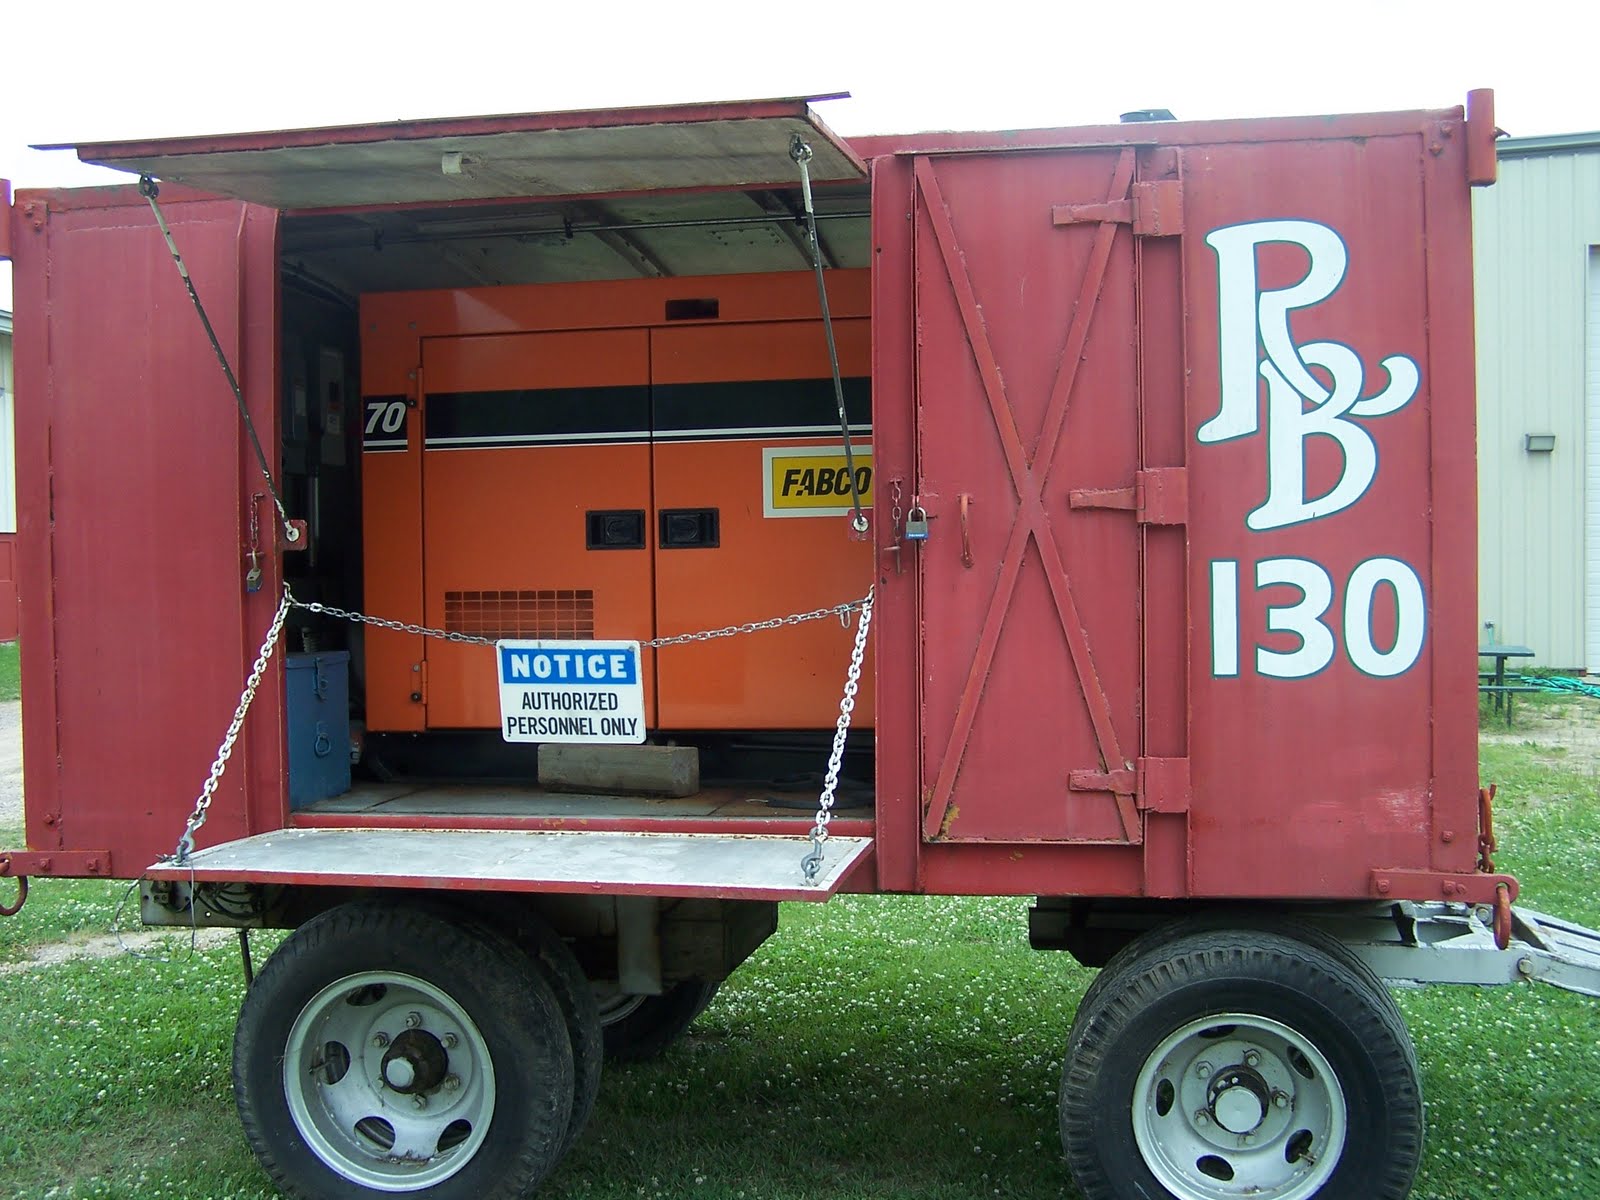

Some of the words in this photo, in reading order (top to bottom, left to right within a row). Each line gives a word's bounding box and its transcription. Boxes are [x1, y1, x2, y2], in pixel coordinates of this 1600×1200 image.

[365, 401, 407, 434] 70
[781, 466, 872, 497] FABCO
[1210, 556, 1427, 678] 130
[510, 653, 628, 679] NOTICE
[522, 691, 618, 711] AUTHORIZED
[507, 716, 597, 736] PERSONNEL
[601, 717, 638, 736] ONLY
